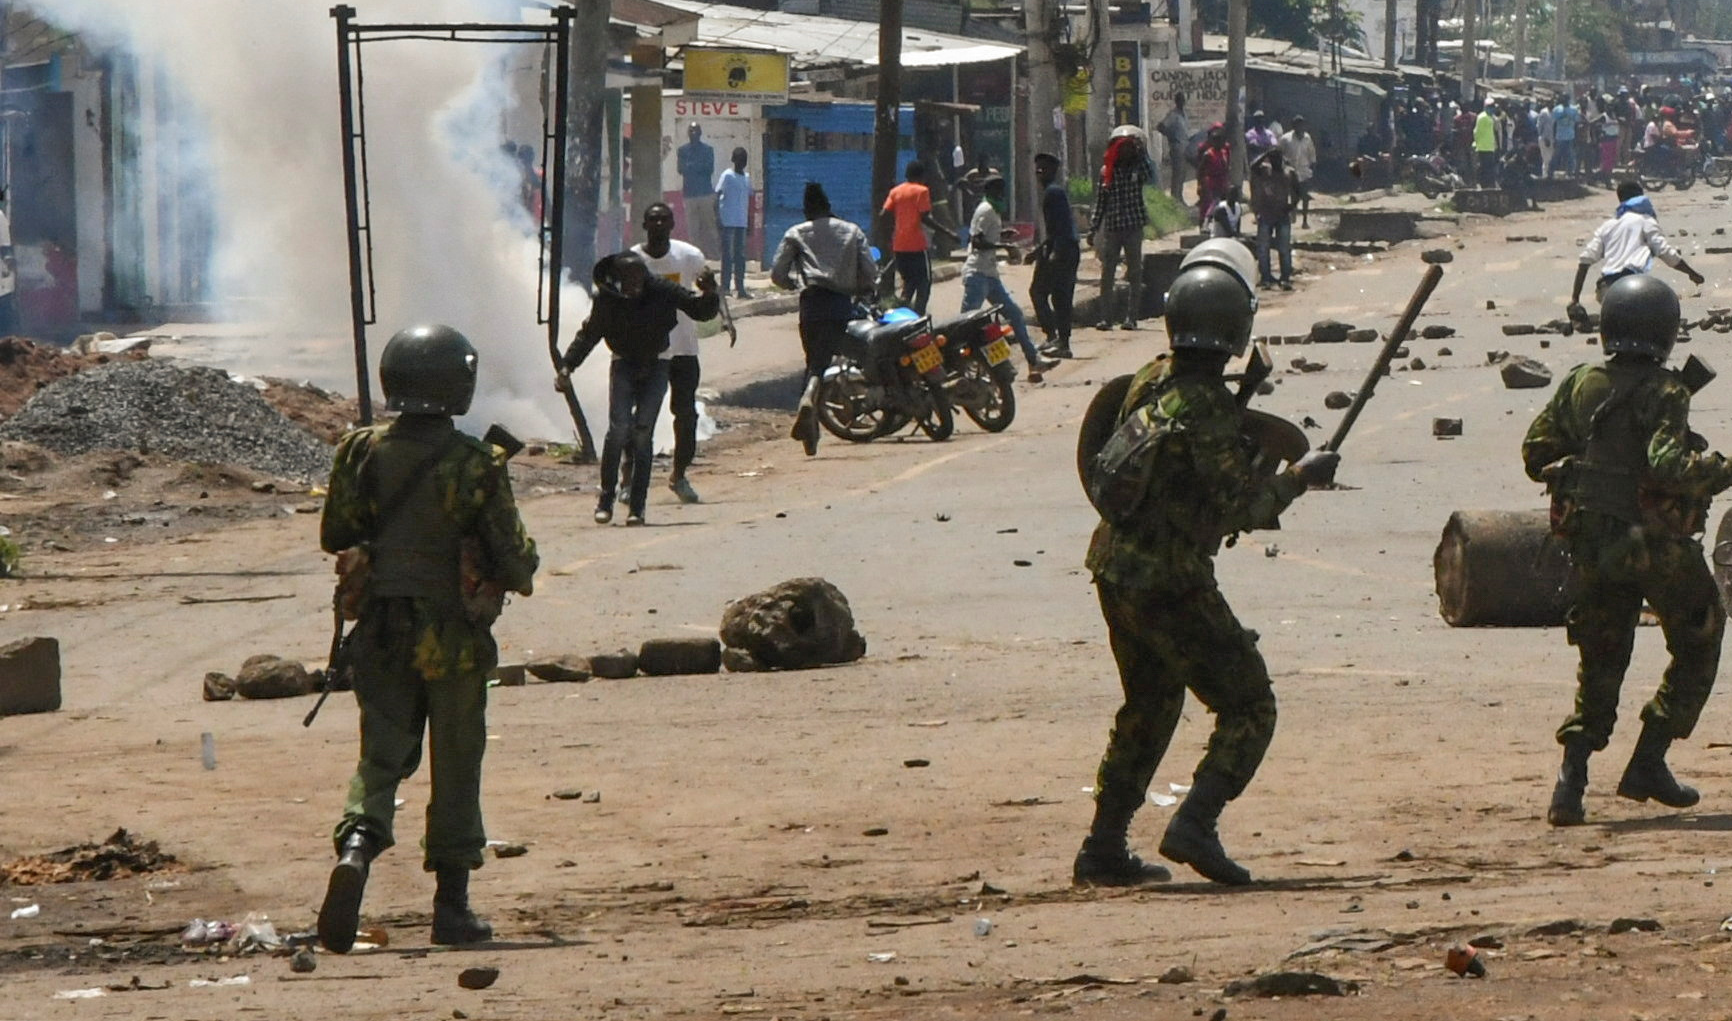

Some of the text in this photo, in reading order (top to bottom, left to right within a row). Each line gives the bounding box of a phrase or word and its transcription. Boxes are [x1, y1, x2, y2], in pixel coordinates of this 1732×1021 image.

[1151, 70, 1193, 82] CANON
[1152, 91, 1228, 101] GUT HOUS
[675, 99, 739, 116] STEVE
